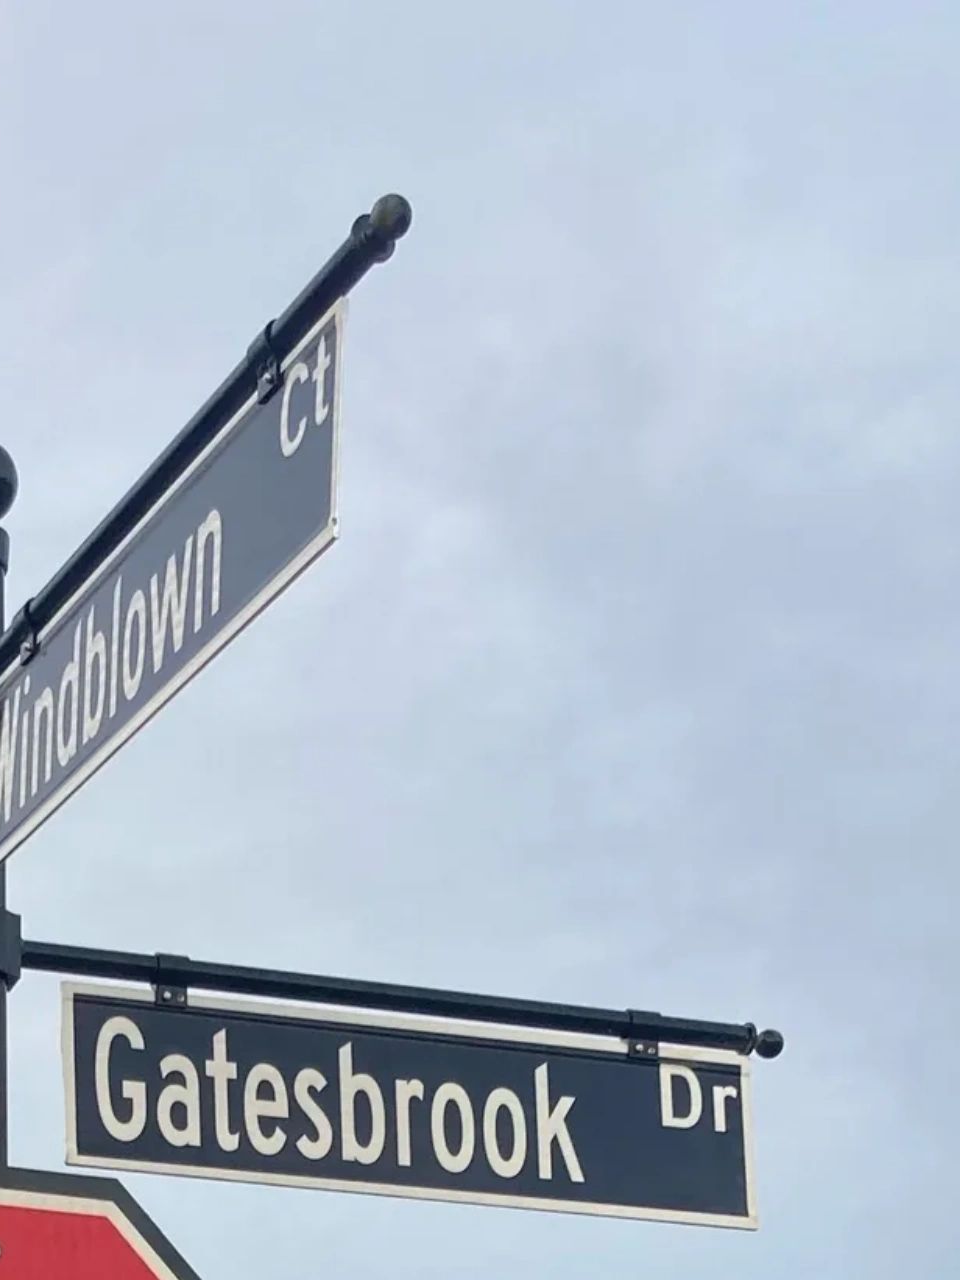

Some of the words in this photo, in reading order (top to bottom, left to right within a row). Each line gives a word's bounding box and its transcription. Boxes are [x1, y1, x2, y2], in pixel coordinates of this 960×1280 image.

[279, 335, 331, 458] Ct
[95, 1015, 585, 1183] Gatesbrook
[659, 1062, 738, 1133] Dr
